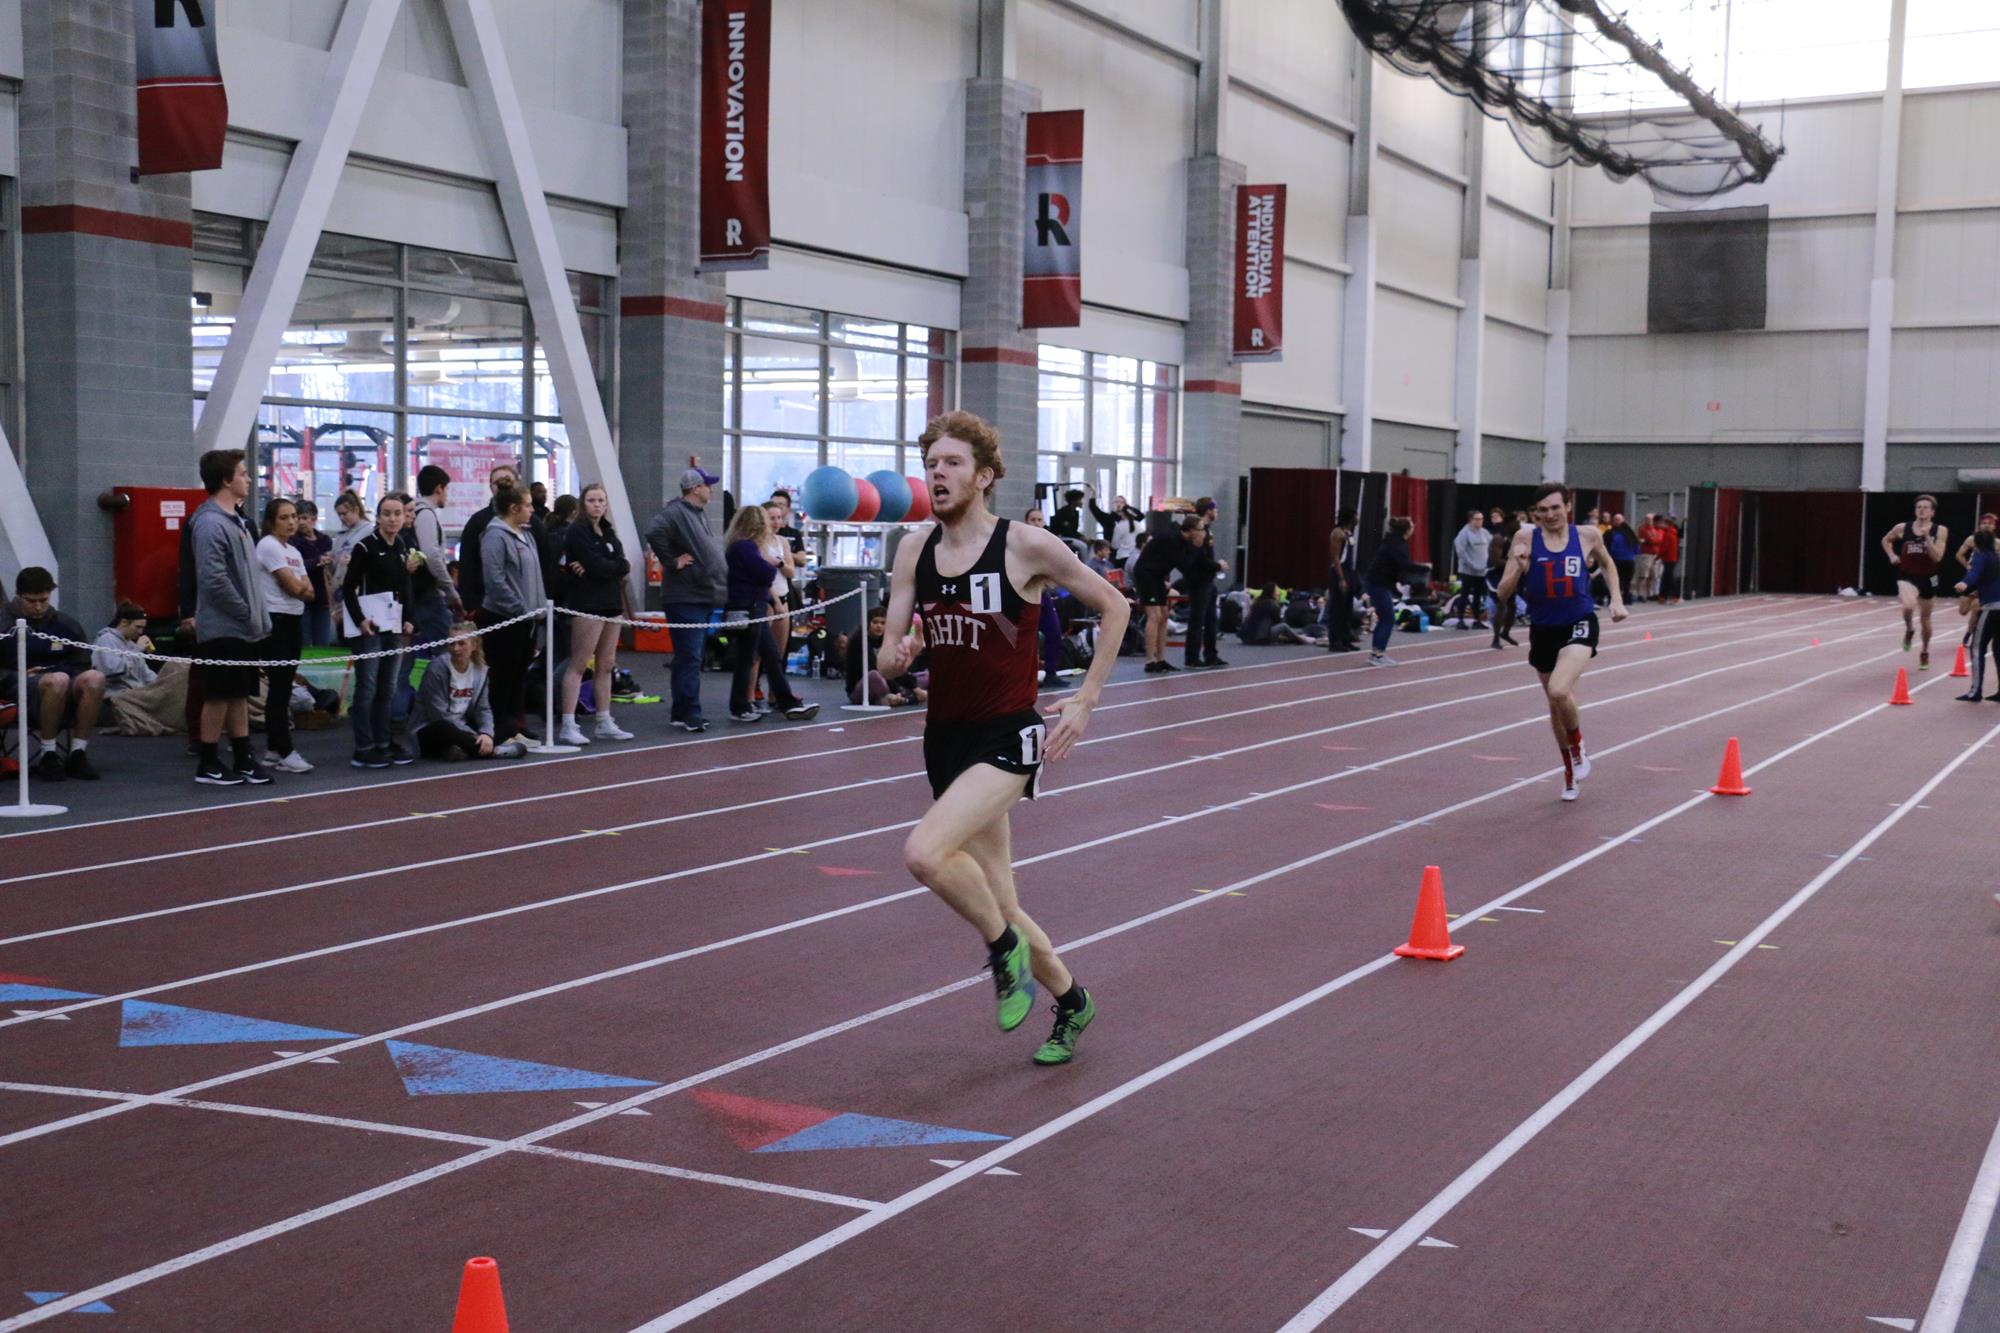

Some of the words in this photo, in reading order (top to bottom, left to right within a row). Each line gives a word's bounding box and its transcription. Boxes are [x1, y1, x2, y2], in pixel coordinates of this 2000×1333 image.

[725, 12, 745, 182] INNOVATION
[726, 218, 743, 246] R
[1245, 194, 1261, 298] ATTENTION
[1258, 194, 1274, 298] INDIVIDUAL
[1251, 328, 1264, 346] R
[1541, 561, 1574, 598] H
[1567, 558, 1578, 575] 5
[975, 576, 991, 611] 1
[926, 614, 986, 651] RHIT
[1575, 622, 1585, 637] 5
[1026, 728, 1038, 761] 1
